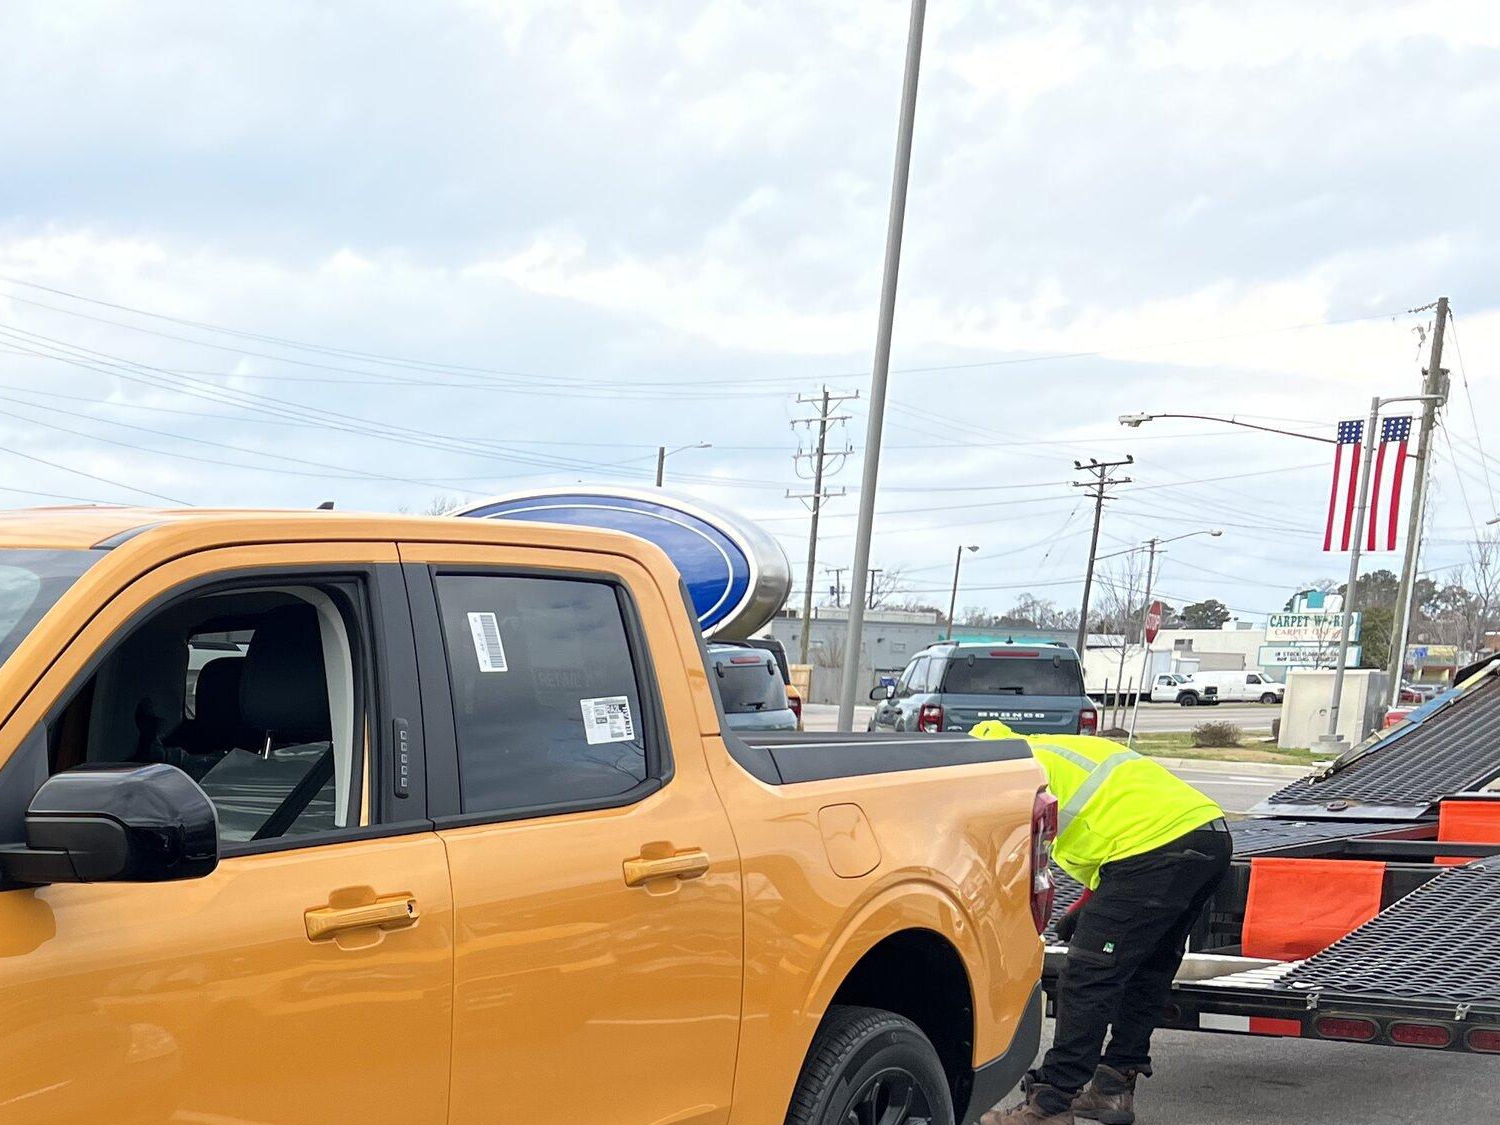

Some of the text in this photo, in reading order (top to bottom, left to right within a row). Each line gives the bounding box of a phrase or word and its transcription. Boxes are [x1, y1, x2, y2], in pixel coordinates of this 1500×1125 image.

[1270, 615, 1354, 627] CARPET WRD
[1275, 628, 1308, 636] CARPET
